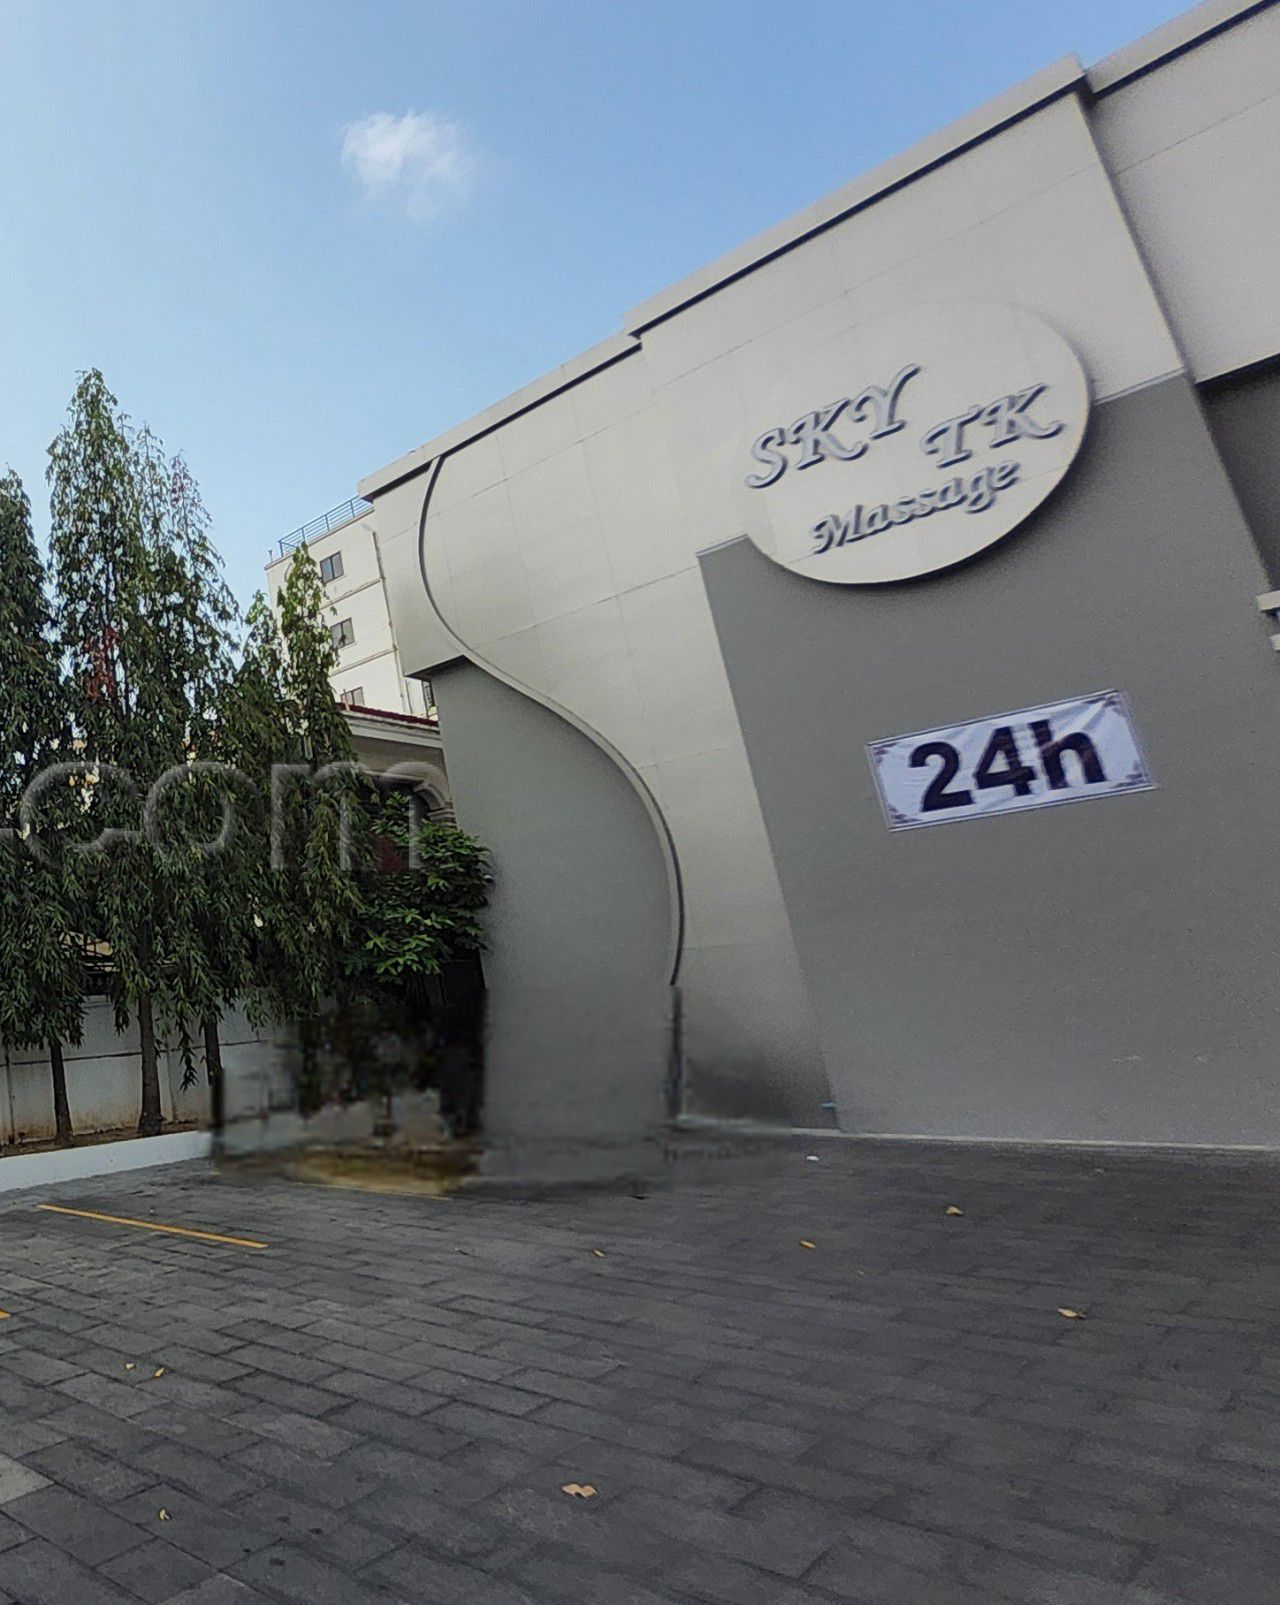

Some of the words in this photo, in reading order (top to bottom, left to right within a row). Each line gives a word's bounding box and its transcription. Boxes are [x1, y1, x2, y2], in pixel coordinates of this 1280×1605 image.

[746, 363, 920, 489] SKY
[925, 384, 1066, 469] TK
[810, 460, 1023, 555] Massage
[908, 718, 1107, 812] 24h
